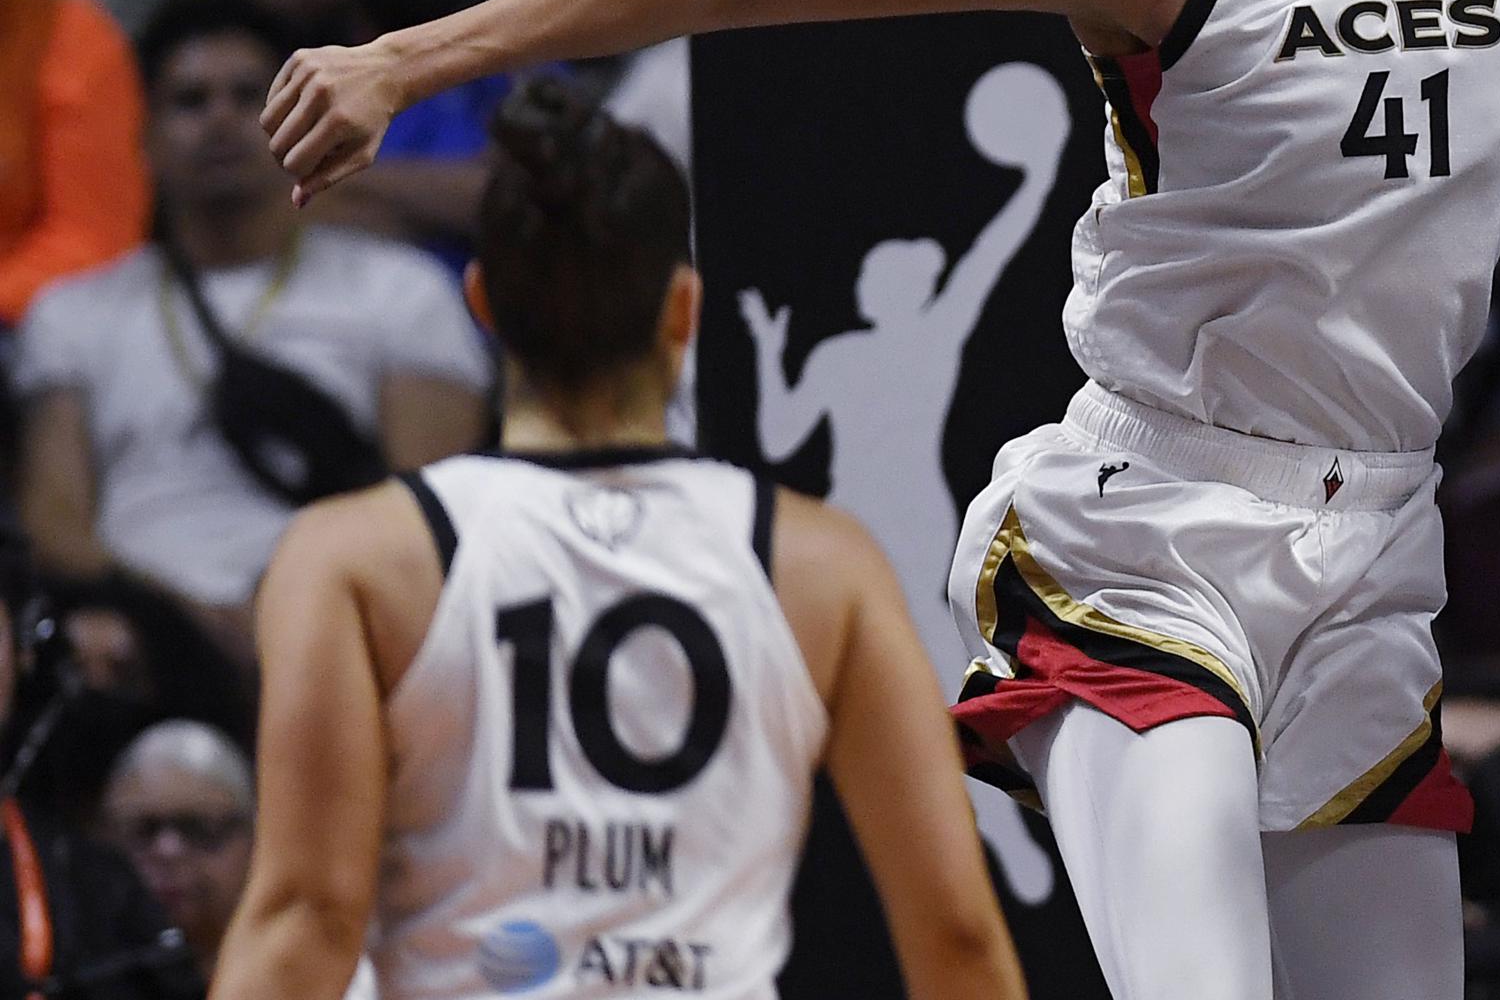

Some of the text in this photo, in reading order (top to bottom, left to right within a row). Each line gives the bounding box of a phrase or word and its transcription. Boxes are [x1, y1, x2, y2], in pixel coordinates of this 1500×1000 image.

[1340, 68, 1451, 180] 41
[495, 591, 732, 795] 10
[543, 817, 675, 895] PLUM
[576, 934, 712, 992] AT&T
